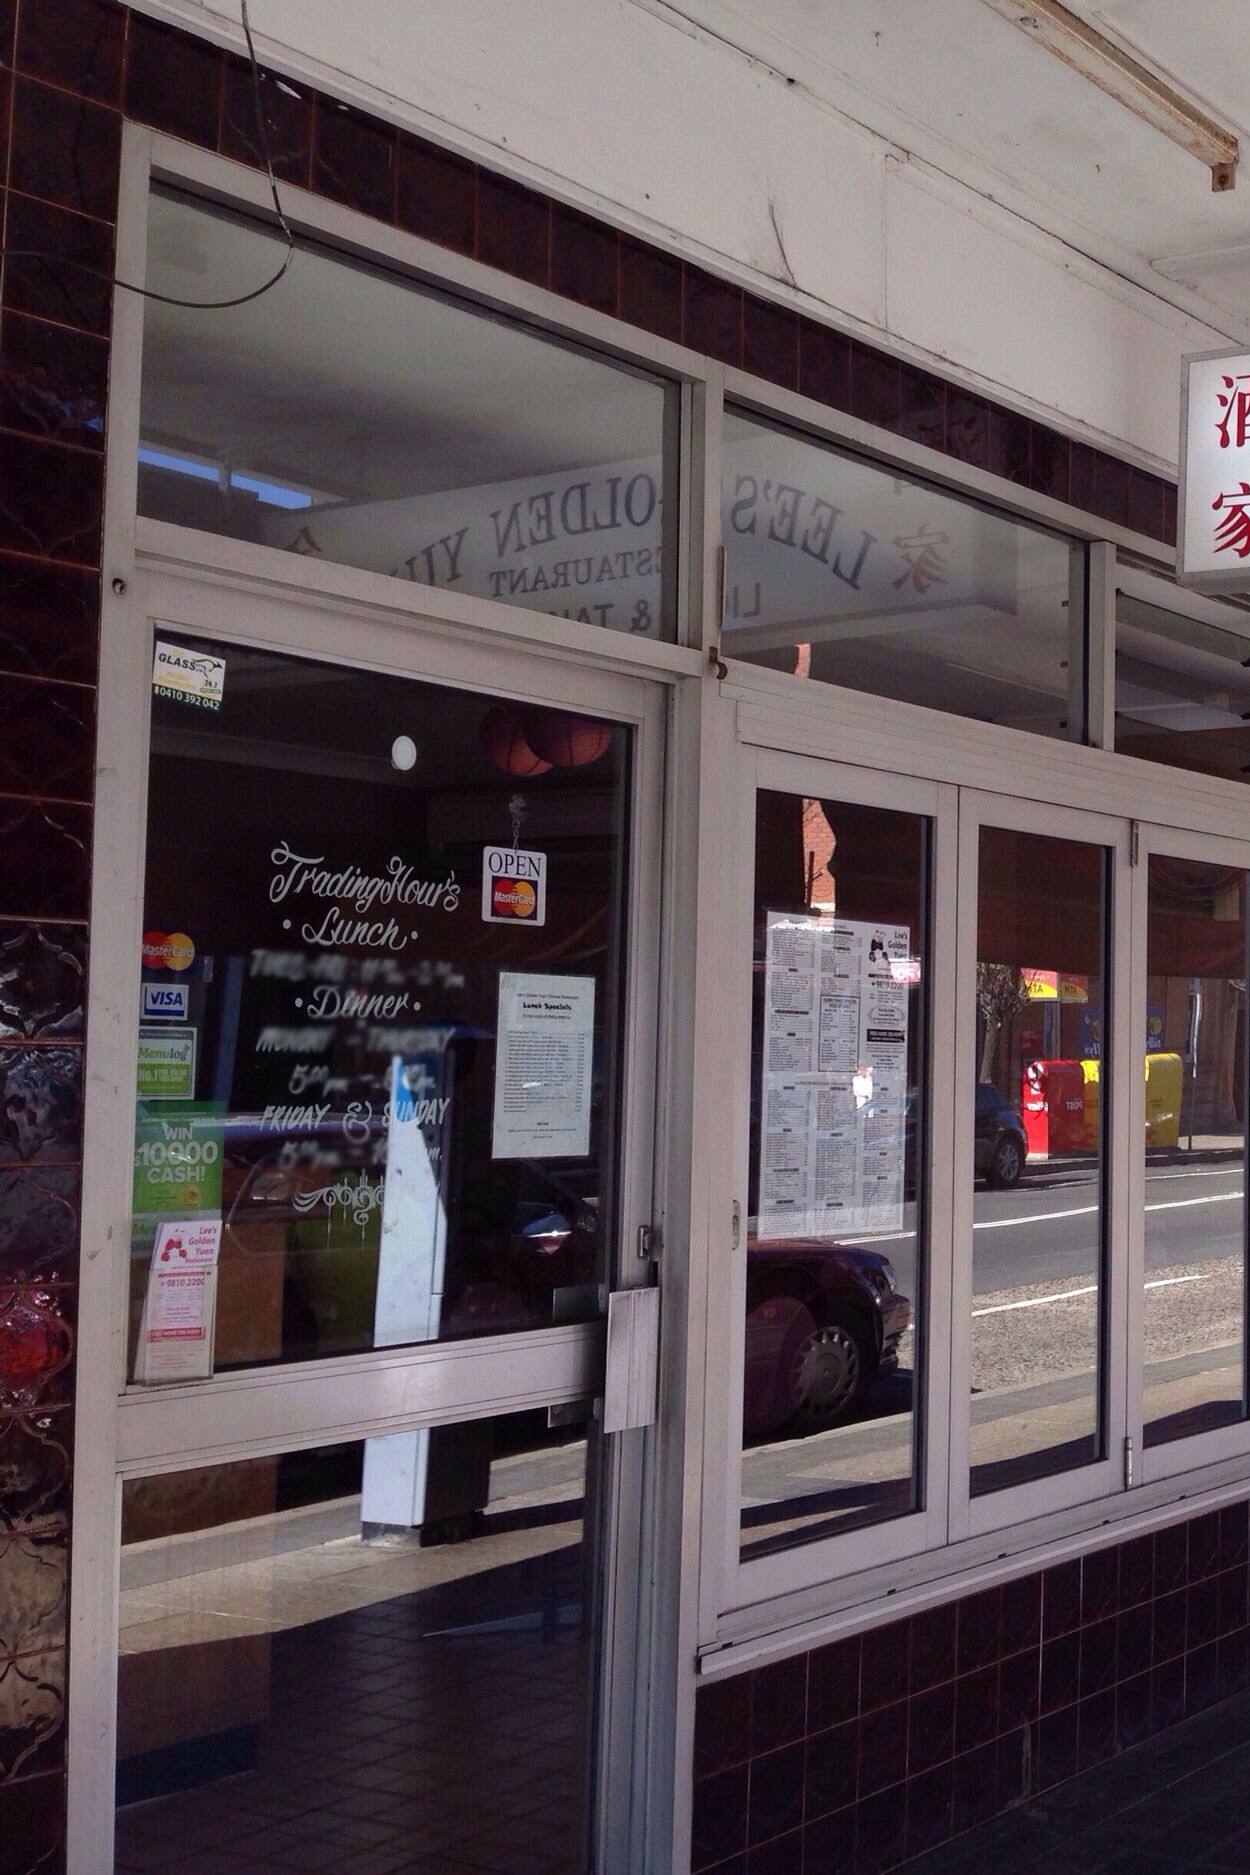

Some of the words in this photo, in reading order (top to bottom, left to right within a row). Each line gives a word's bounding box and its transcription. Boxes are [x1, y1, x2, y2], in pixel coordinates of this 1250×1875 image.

[158, 652, 196, 672] GLASS
[160, 686, 183, 701] 0410
[183, 692, 201, 706] 392
[202, 697, 220, 710] 042
[488, 851, 542, 878] OPEN
[269, 840, 384, 913] Trading
[493, 891, 536, 905] MasterCard
[301, 906, 408, 950] Lunch
[150, 991, 184, 1006] VISA
[306, 984, 410, 1019] Dinner
[259, 1103, 332, 1132] FRIDAY
[161, 1121, 194, 1140] WIN
[147, 1165, 206, 1185] CASH!
[188, 1236, 216, 1246] Golden
[194, 1248, 215, 1256] Yuen
